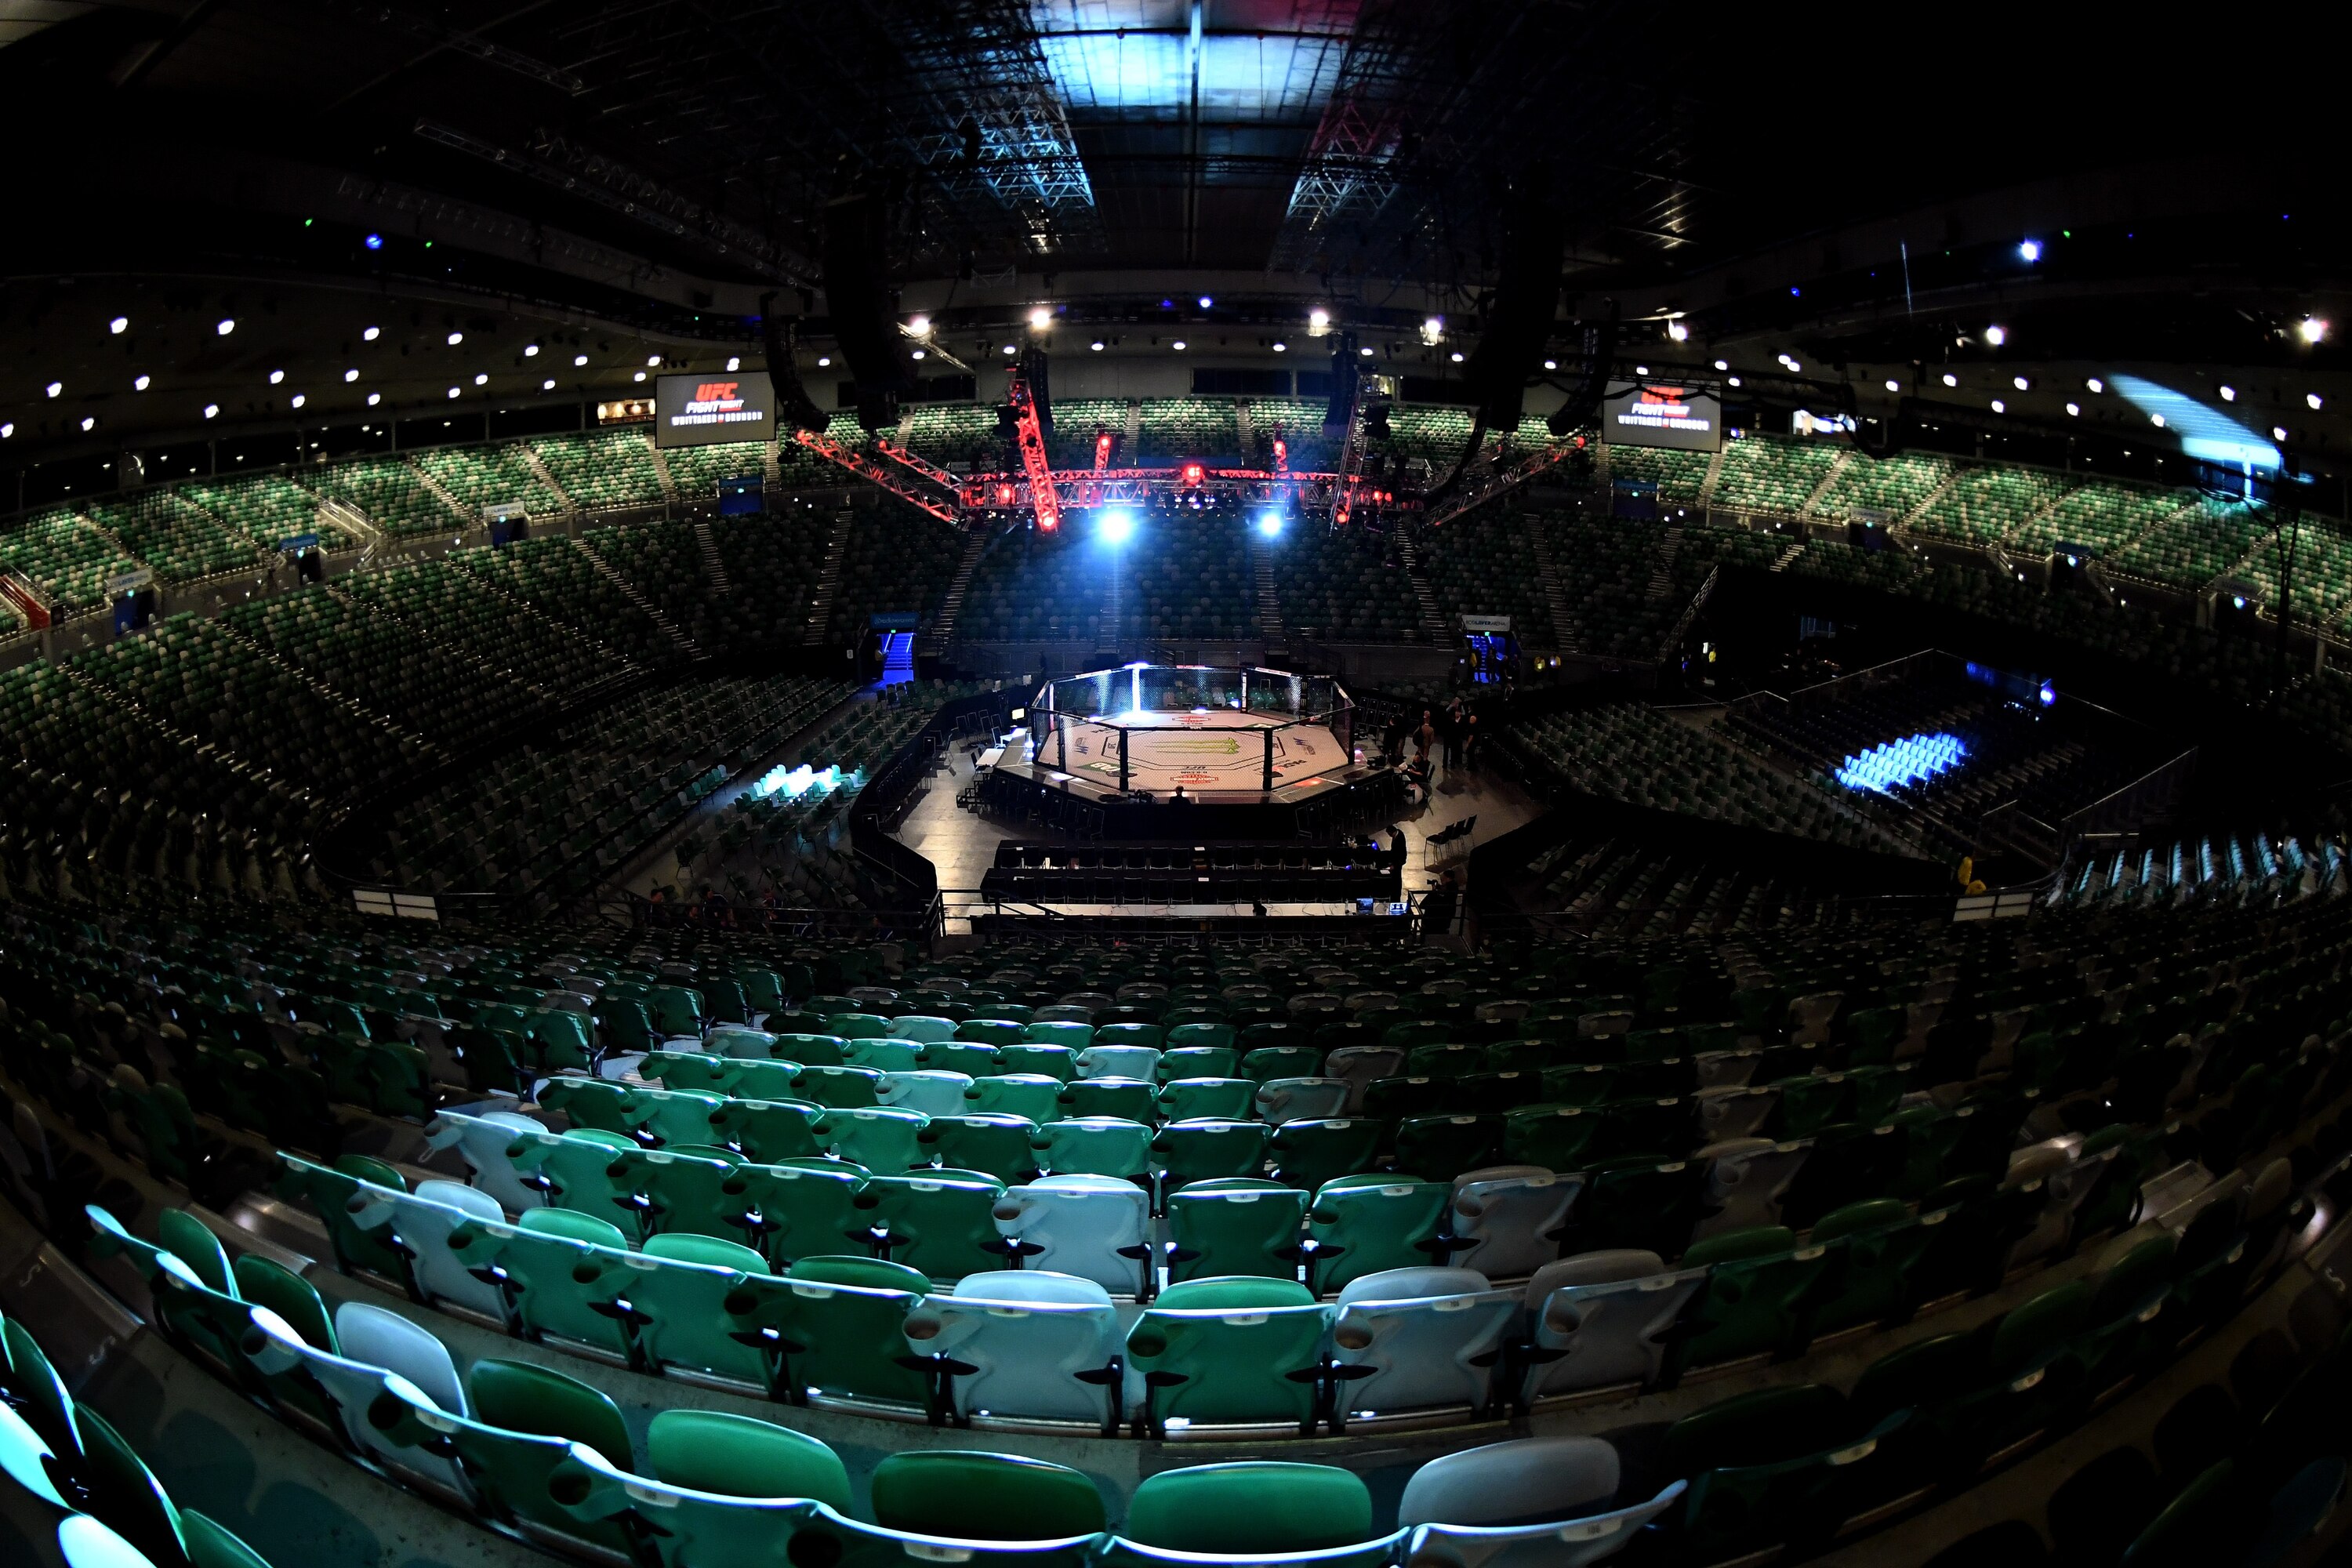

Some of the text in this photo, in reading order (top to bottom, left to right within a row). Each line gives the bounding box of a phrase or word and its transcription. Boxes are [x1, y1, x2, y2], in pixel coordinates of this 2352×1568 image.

[695, 383, 738, 401] UFC
[686, 401, 720, 414] FIGHT
[1632, 403, 1664, 416] FIGHT
[671, 414, 717, 426] WHITTAKER
